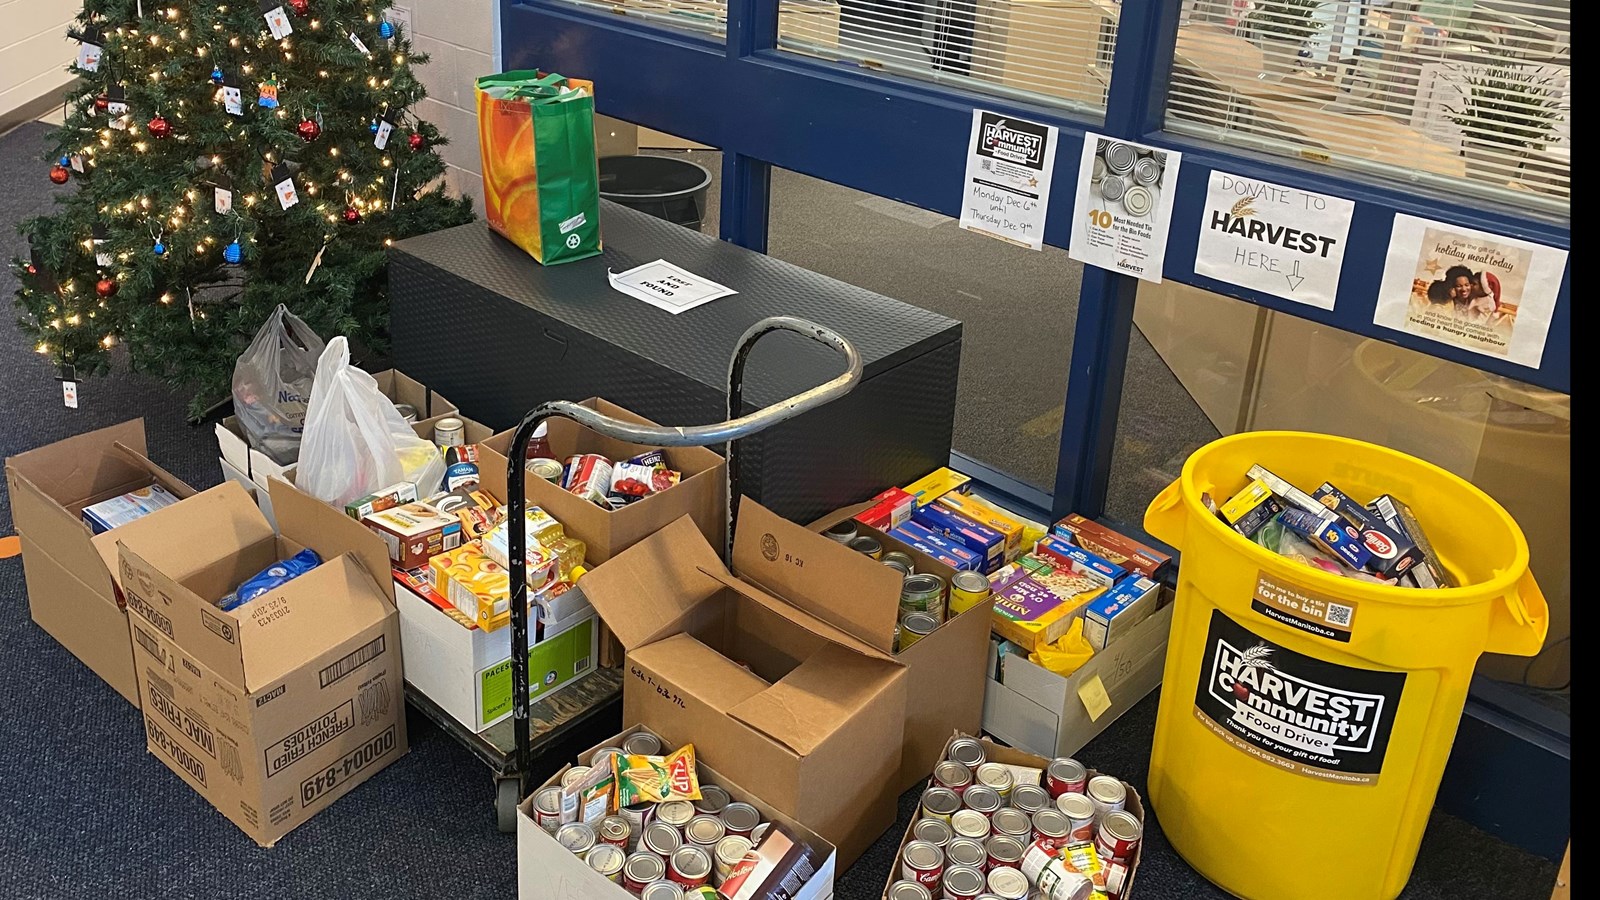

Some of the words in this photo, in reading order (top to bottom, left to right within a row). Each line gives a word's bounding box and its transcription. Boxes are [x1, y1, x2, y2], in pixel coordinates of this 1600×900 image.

[986, 126, 1040, 149] HARVEST
[1010, 152, 1024, 161] Drive
[973, 186, 1004, 205] Monday
[1006, 195, 1021, 208] Dec
[1023, 200, 1038, 211] 6th
[1222, 176, 1290, 205] DONATE
[1299, 192, 1326, 210] TO
[970, 208, 1002, 228] Thursday
[1003, 219, 1018, 231] Dec
[1020, 222, 1033, 234] 9th
[990, 204, 1007, 214] until
[1088, 209, 1113, 229] 10
[1113, 216, 1126, 225] Most
[1126, 219, 1144, 229] Needed
[1144, 223, 1153, 231] Tin
[1128, 227, 1137, 235] Bin
[1137, 229, 1152, 239] Foods
[1211, 210, 1336, 258] HARVEST
[1234, 247, 1281, 273] HERE
[1435, 243, 1466, 262] holiday
[1467, 251, 1488, 264] meal
[1489, 256, 1514, 273] today
[1452, 240, 1466, 248] Give
[1467, 242, 1477, 250] the
[1478, 245, 1488, 253] gift
[667, 275, 693, 286] LOST
[1116, 261, 1144, 273] HARVEST
[640, 281, 674, 296] FOUND
[656, 280, 680, 289] AND
[1409, 316, 1435, 329] feeding
[1442, 325, 1467, 338] hungry
[1468, 332, 1506, 347] neighbour
[1422, 315, 1437, 325] your
[1436, 317, 1453, 327] heart
[1453, 321, 1465, 330] that
[1465, 325, 1486, 335] comes
[1486, 331, 1500, 340] with
[1437, 312, 1453, 321] know
[1463, 320, 1494, 333] goodness
[644, 455, 661, 466] HEINZ
[1258, 586, 1277, 600] for
[1277, 592, 1299, 608] the
[1301, 601, 1324, 618] bin
[1259, 578, 1275, 589] Scan
[1287, 588, 1294, 597] to
[1294, 591, 1309, 603] buy
[1315, 599, 1325, 607] tin
[1265, 607, 1335, 638] HarvestManitoba.ca
[1220, 648, 1375, 722] HARVEST
[150, 687, 183, 728] FRIES
[1218, 672, 1368, 742] Community
[185, 717, 213, 753] MAC
[284, 712, 337, 751] POTATOES
[308, 717, 349, 750] FRENCH
[1226, 717, 1247, 735] Thank
[1247, 731, 1262, 743] you
[1262, 735, 1274, 747] for
[1274, 742, 1293, 755] your
[1293, 748, 1309, 762] gift
[1309, 753, 1319, 762] of
[1318, 756, 1341, 766] food!
[1246, 711, 1280, 734] Food
[1284, 728, 1323, 748] Drive
[148, 719, 204, 782] 00004-849
[273, 745, 305, 770] FRIED
[1196, 711, 1206, 721] For
[1205, 717, 1214, 728] bin
[1213, 724, 1225, 738] pick
[1225, 733, 1235, 744] up,
[1235, 740, 1247, 750] call
[1247, 746, 1295, 769] 204.982.3663
[1301, 767, 1370, 783] HarvestManitoba.ca
[303, 730, 393, 802] 00004-849
